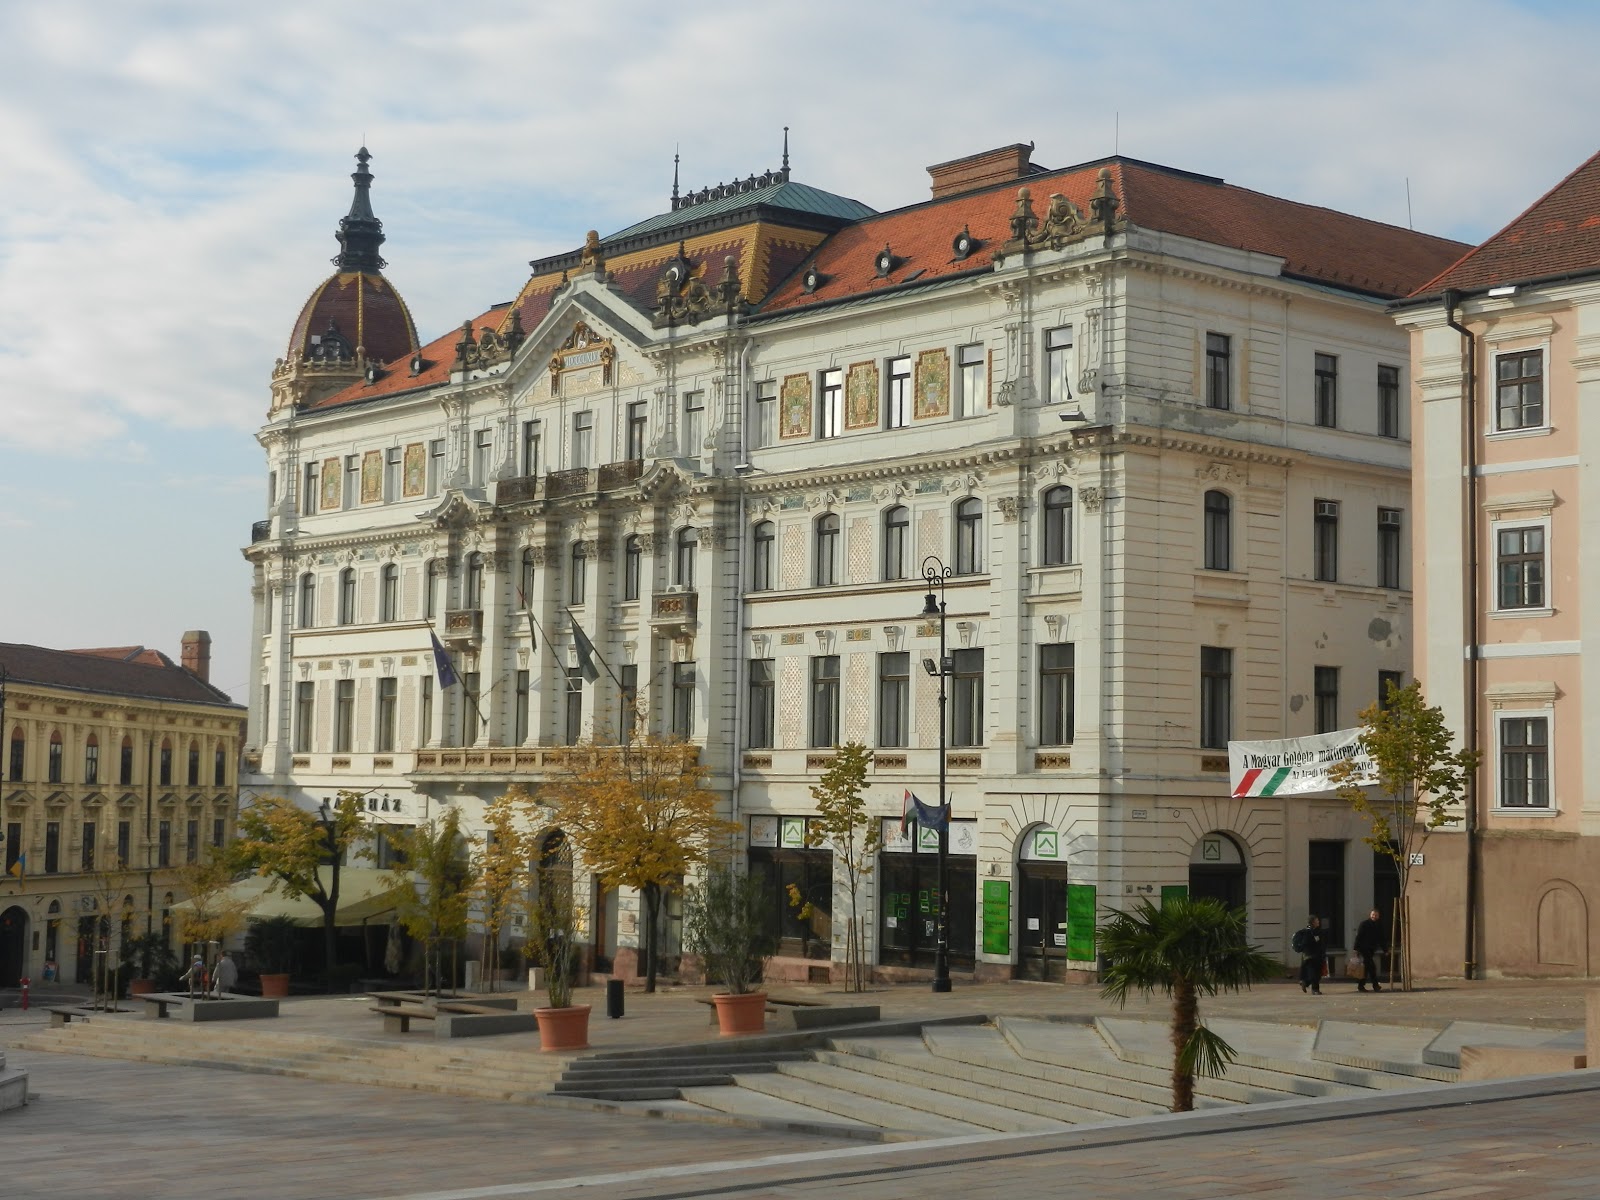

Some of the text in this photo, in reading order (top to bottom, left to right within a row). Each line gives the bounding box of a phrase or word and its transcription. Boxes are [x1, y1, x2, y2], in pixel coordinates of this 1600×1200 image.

[1243, 754, 1249, 769] A
[1251, 753, 1281, 770] Magyar
[322, 792, 402, 812] KÁHÁZ
